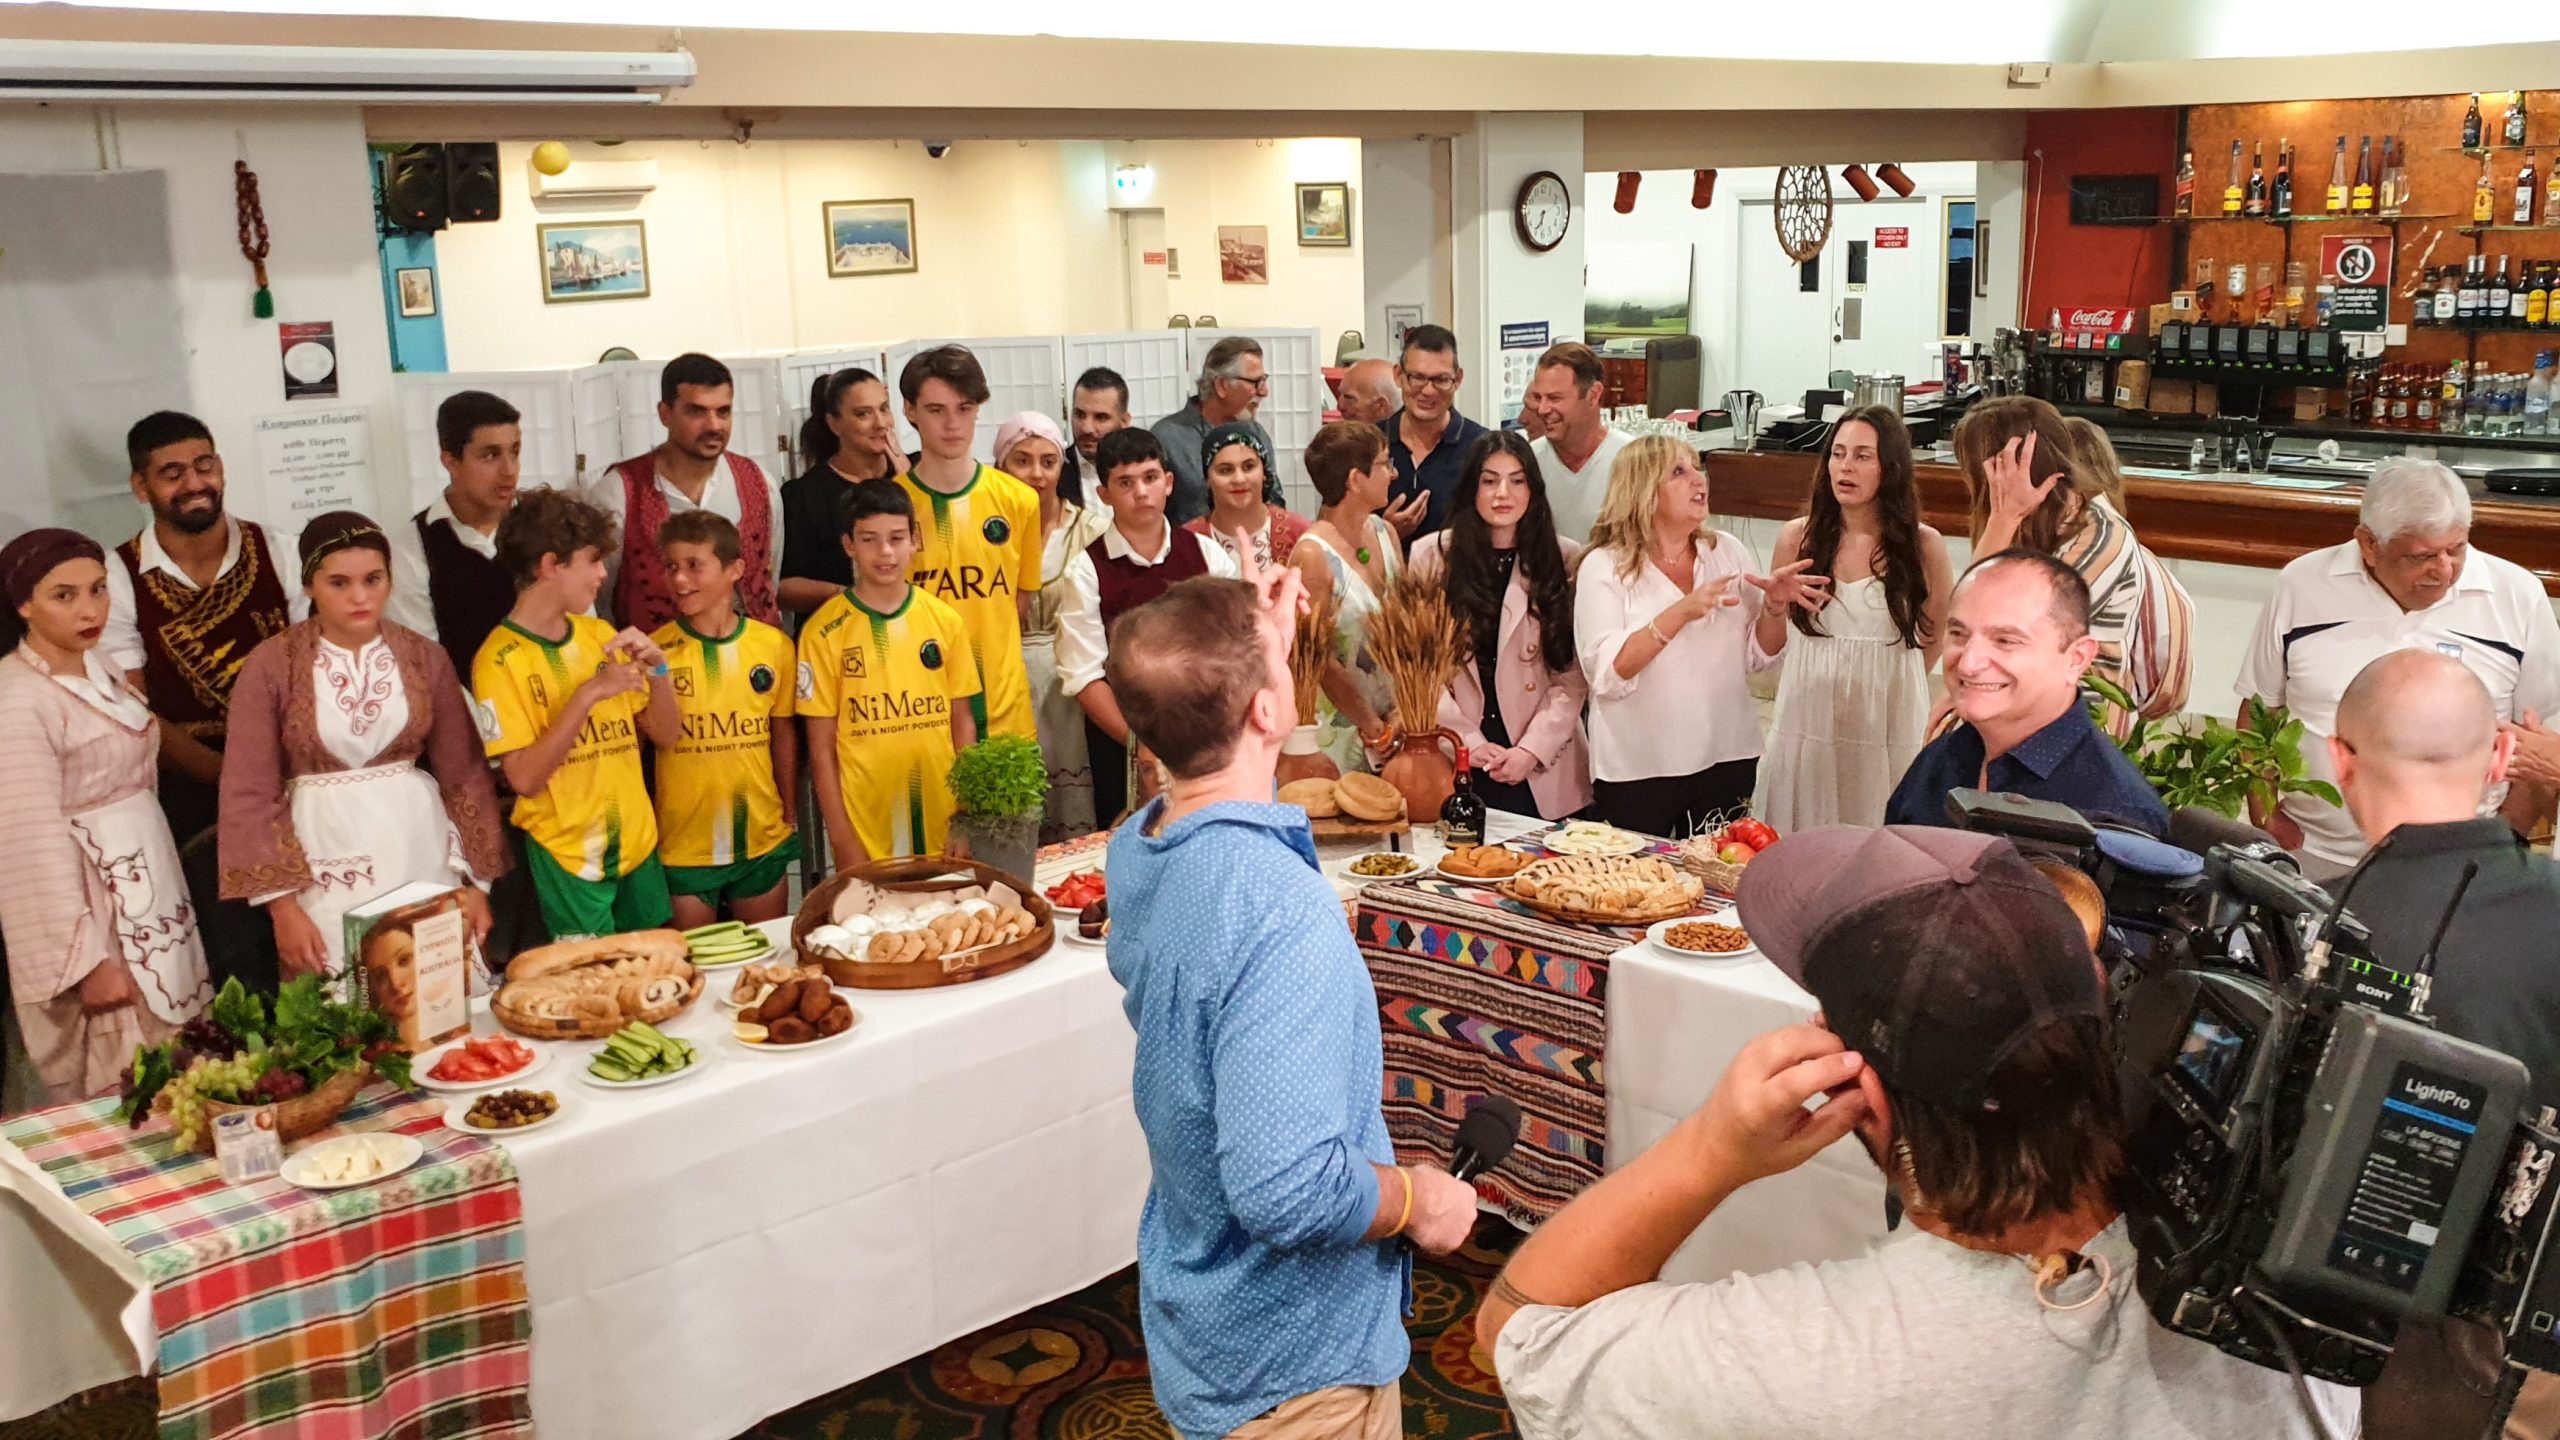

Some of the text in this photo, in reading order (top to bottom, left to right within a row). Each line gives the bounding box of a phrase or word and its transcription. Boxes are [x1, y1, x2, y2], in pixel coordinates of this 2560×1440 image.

[848, 690, 947, 724] NiMera
[575, 714, 633, 746] Mera
[880, 724, 910, 735] NIGHT
[912, 718, 950, 731] POWDERS
[2355, 982, 2394, 1002] SONY
[2404, 1078, 2471, 1110] LightPro
